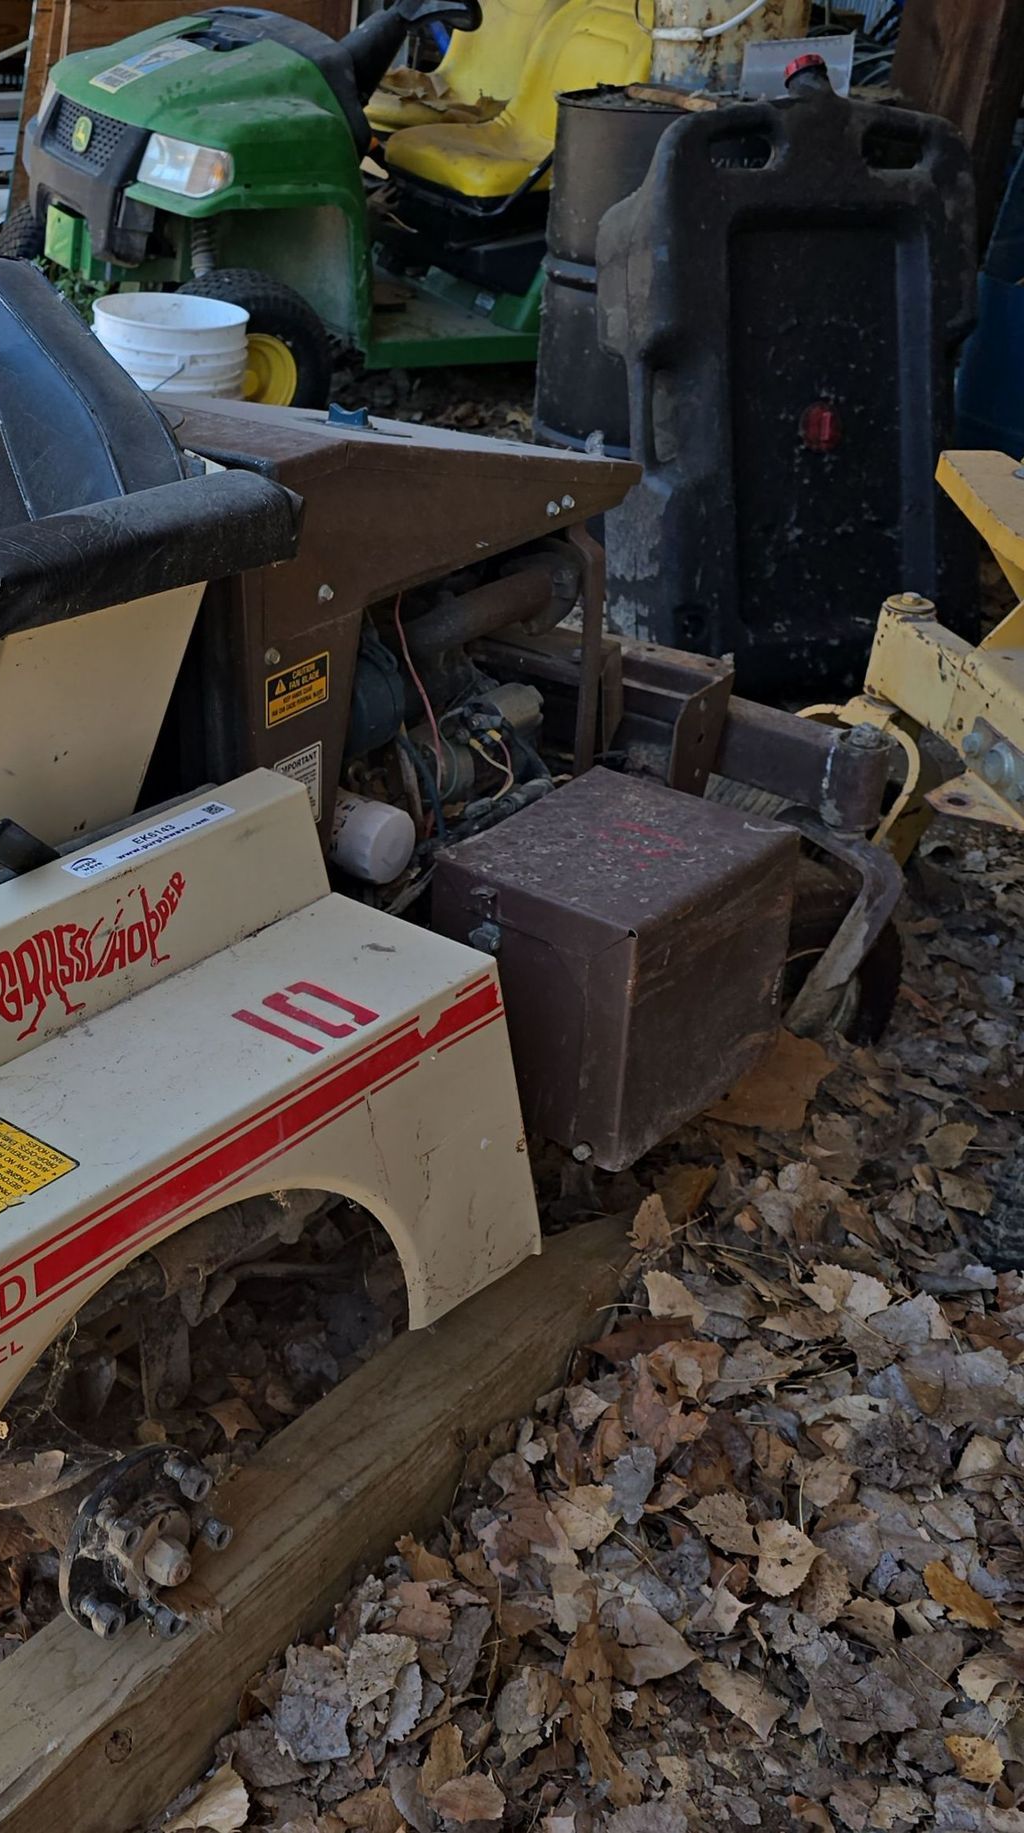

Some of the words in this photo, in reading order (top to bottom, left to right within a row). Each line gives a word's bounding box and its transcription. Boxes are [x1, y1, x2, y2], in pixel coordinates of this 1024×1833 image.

[117, 817, 210, 860] www.purplewave.com
[132, 824, 176, 845] EK6143
[1, 1155, 17, 1165] NO
[27, 1159, 52, 1174] AVOID
[47, 1152, 67, 1164] AND
[2, 1167, 32, 1185] ENGINE
[13, 1162, 42, 1179] ALLOW
